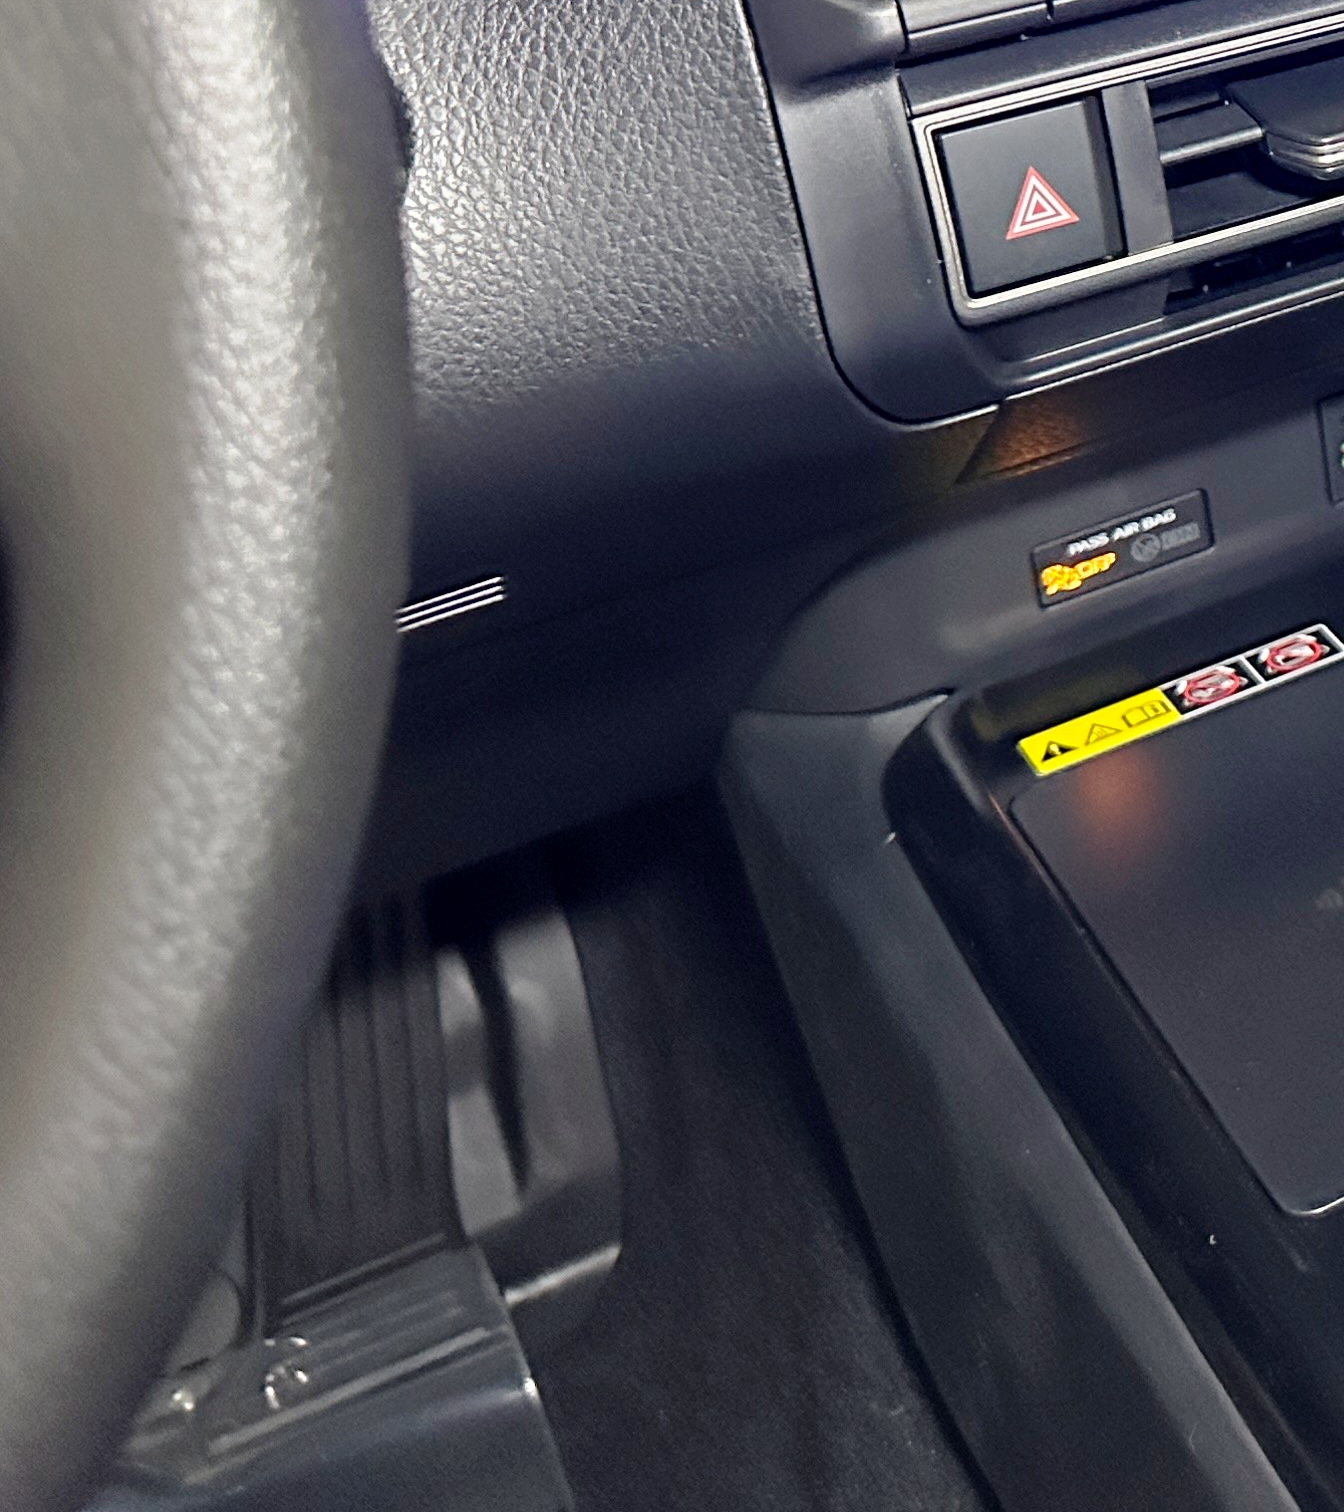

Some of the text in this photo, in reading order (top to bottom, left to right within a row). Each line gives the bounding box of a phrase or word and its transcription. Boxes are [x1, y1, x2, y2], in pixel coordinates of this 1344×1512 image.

[1066, 508, 1177, 556] PASS AIR BAG
[1075, 552, 1117, 579] OFF
